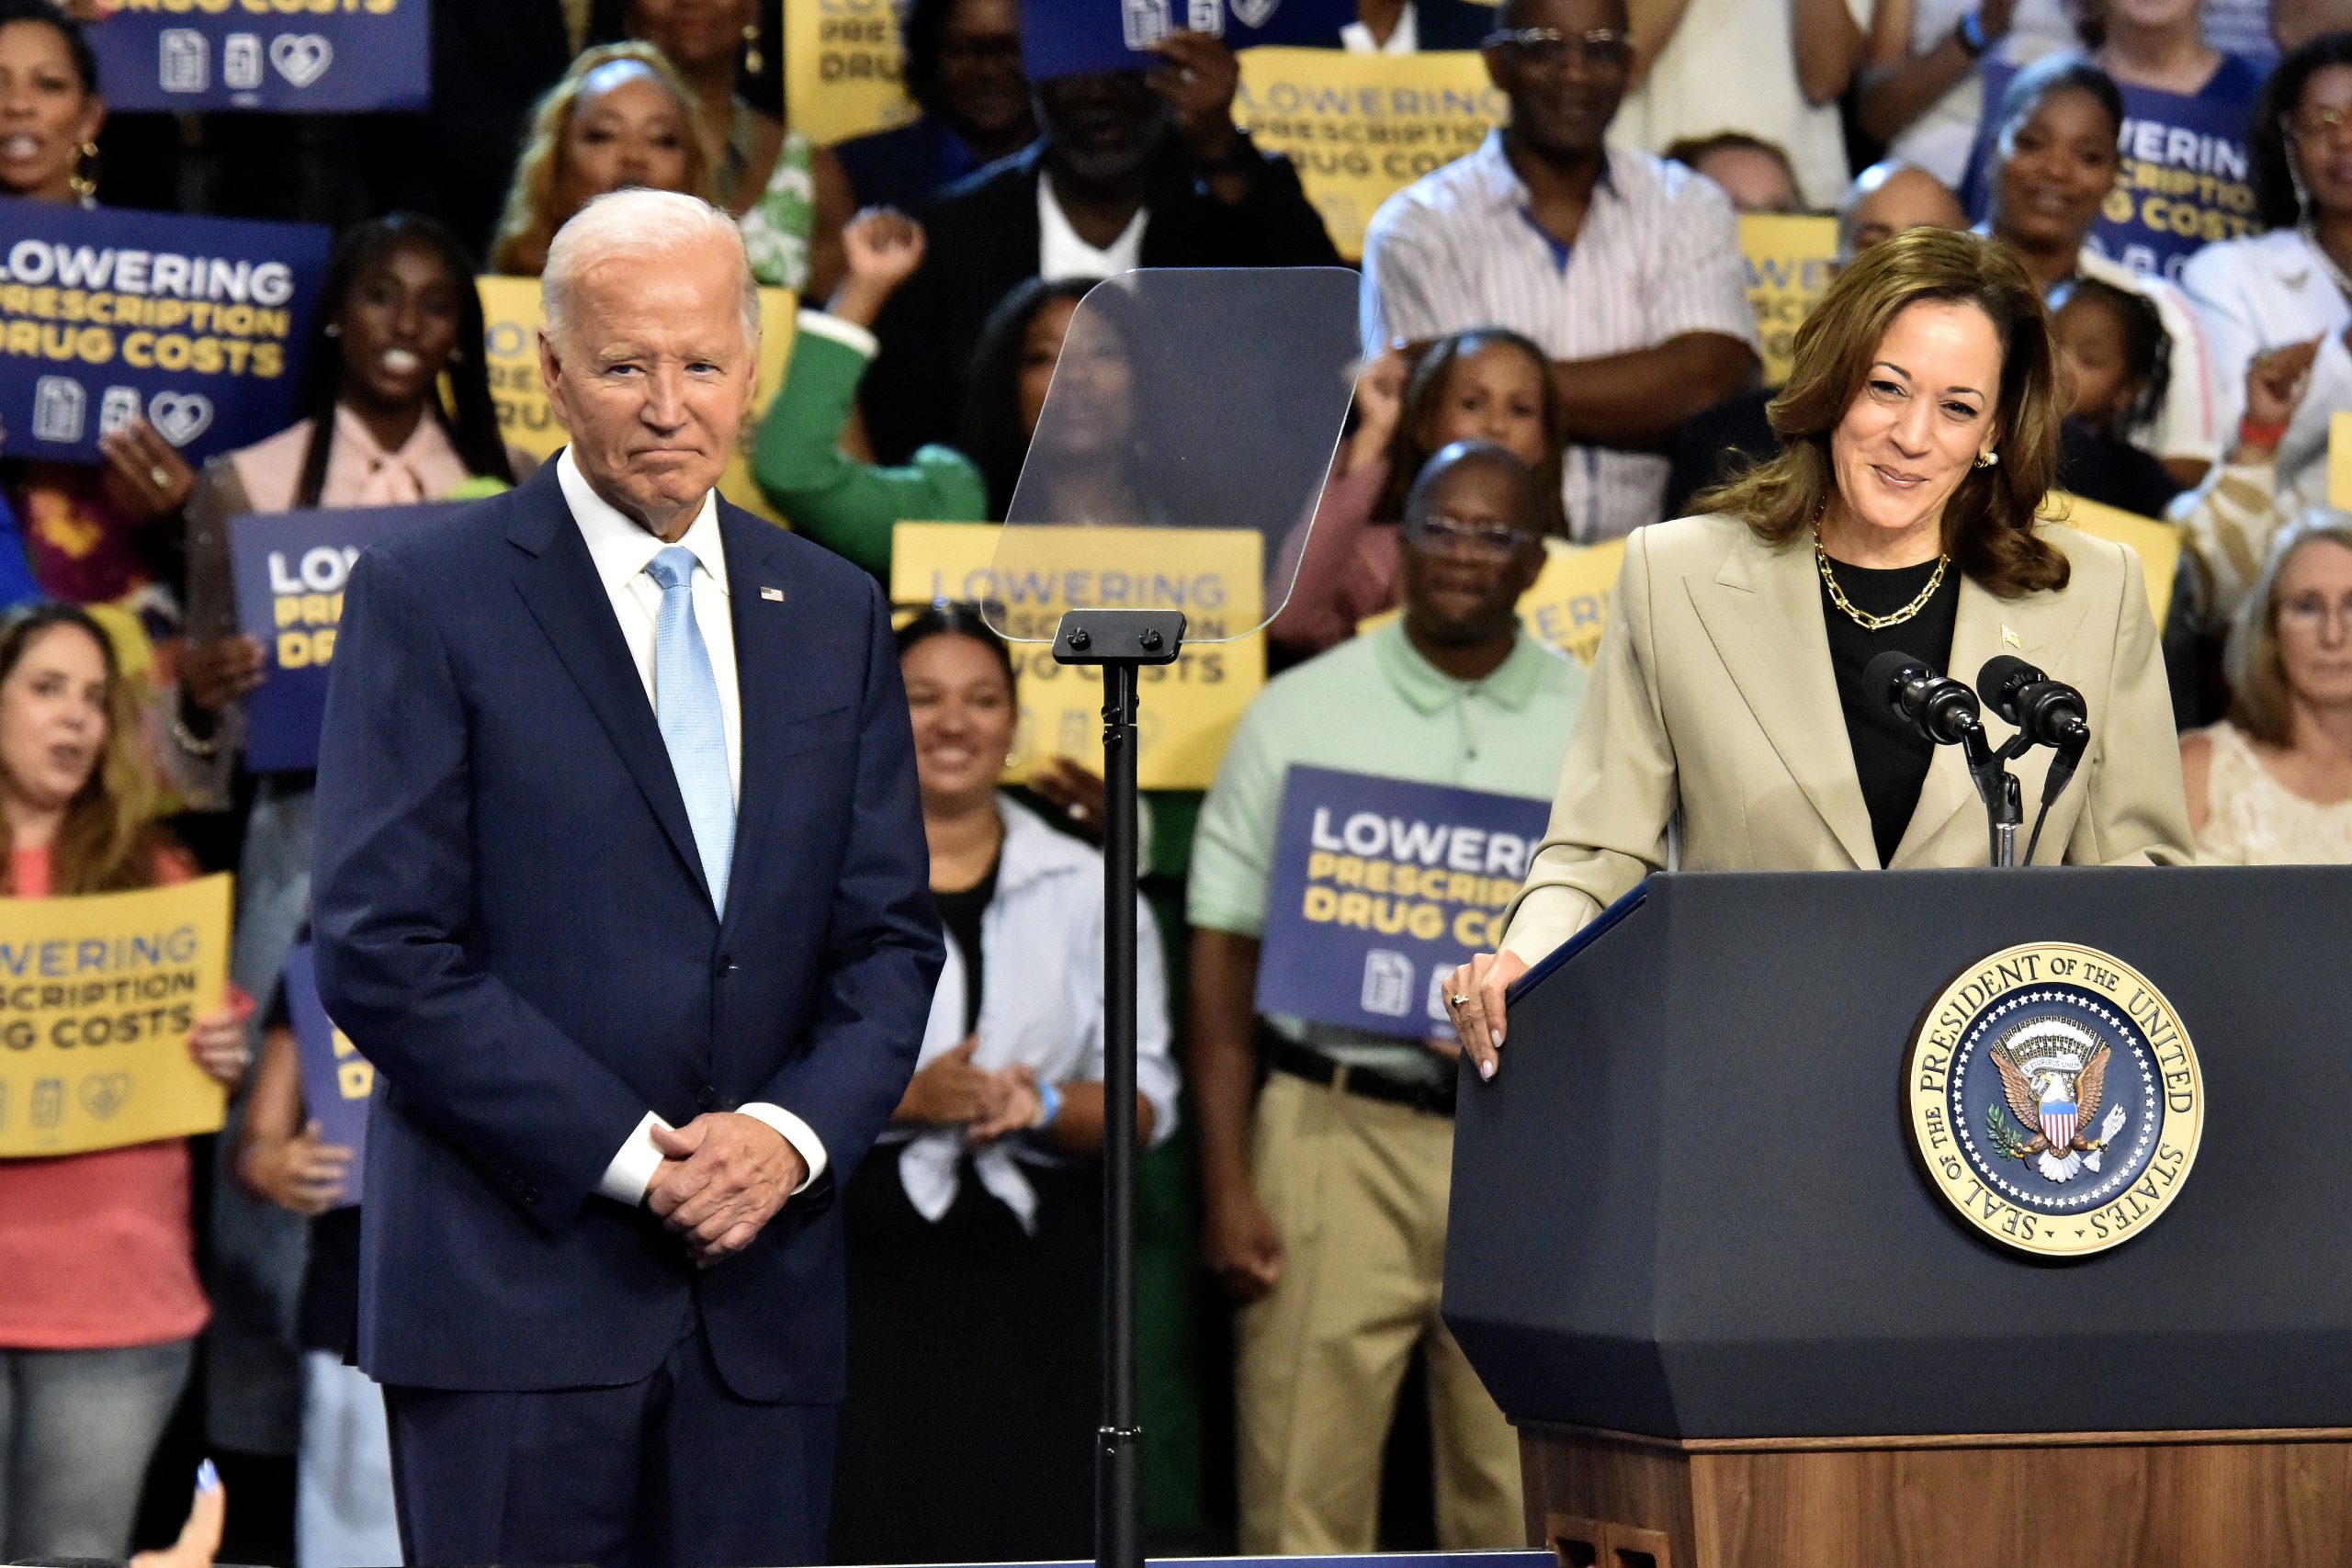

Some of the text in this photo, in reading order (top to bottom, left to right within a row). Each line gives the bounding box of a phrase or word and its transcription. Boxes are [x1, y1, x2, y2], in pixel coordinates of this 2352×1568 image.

[0, 239, 294, 306] OWERING
[0, 284, 291, 337] RESCRIPTION
[0, 321, 284, 378] RUG COSTS
[268, 546, 360, 593] LO
[932, 569, 1226, 610] LOWERING
[1308, 851, 1526, 908] PRESCRIP
[1304, 886, 1445, 941] DRUG
[0, 970, 196, 1011] CRIPTION
[51, 1002, 192, 1049] COSTS
[1920, 954, 2193, 1240] SEAL OF THE PRESIDENT OF THE UNITED STATES
